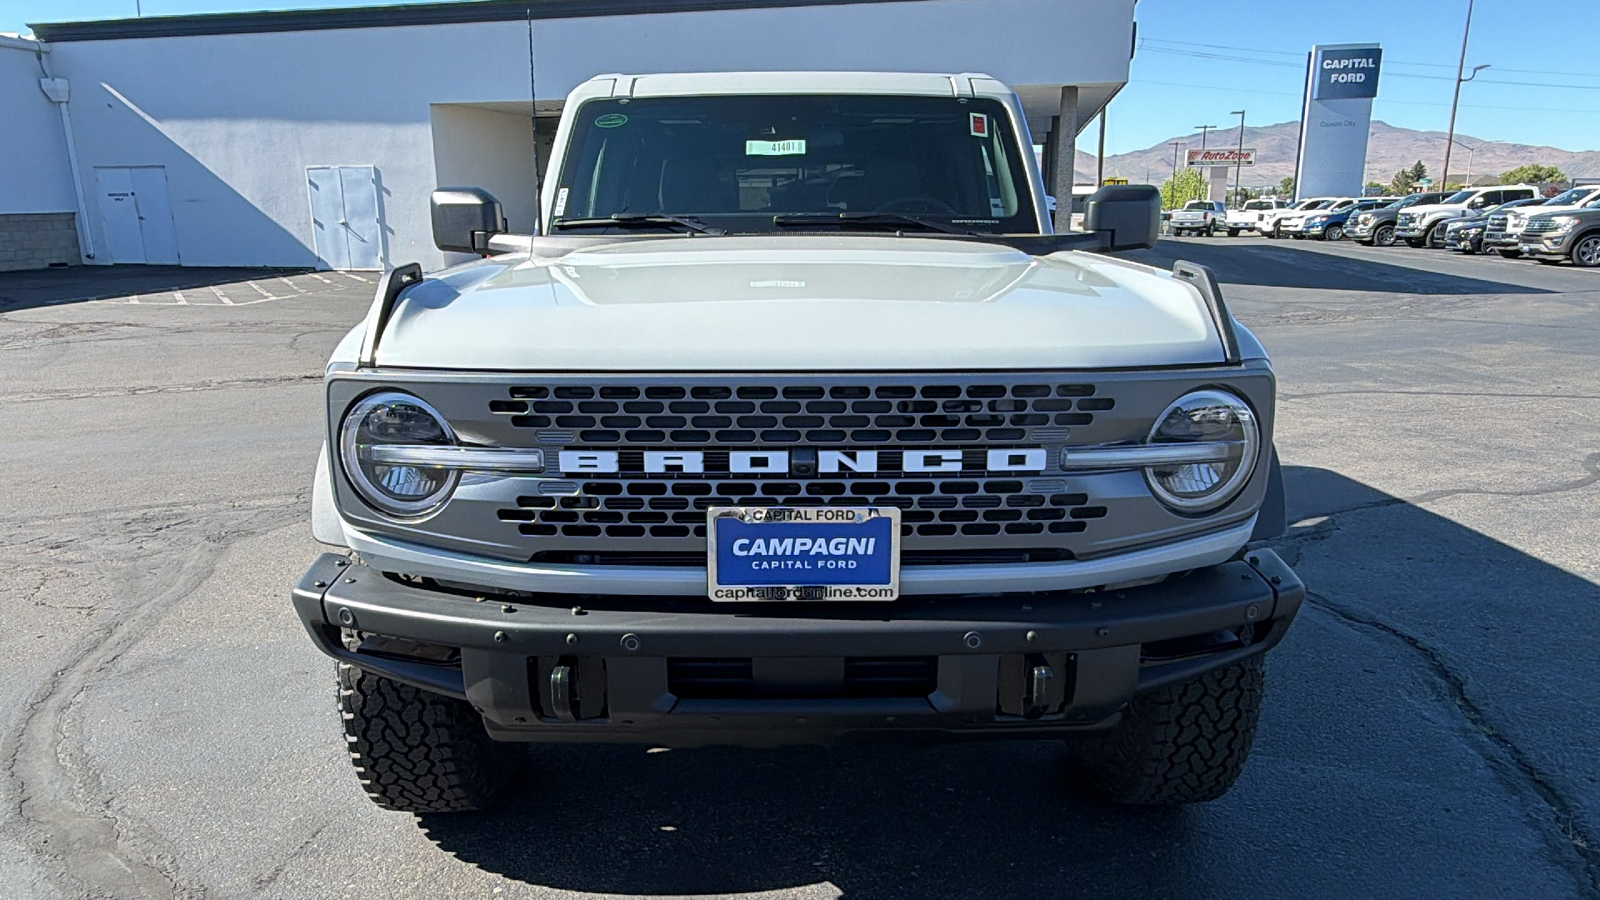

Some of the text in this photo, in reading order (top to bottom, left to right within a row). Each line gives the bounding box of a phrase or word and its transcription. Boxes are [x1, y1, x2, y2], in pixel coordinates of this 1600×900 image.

[1322, 58, 1376, 69] CAPITAL
[1330, 73, 1366, 83] FORD
[771, 142, 795, 152] 41401
[558, 448, 1047, 473] BRONCO
[752, 509, 856, 521] CAPITAL FORD
[732, 537, 876, 556] CAMPAGNI
[751, 560, 858, 570] CAPITAL FORD
[714, 585, 894, 600] capitalfordonline.com
